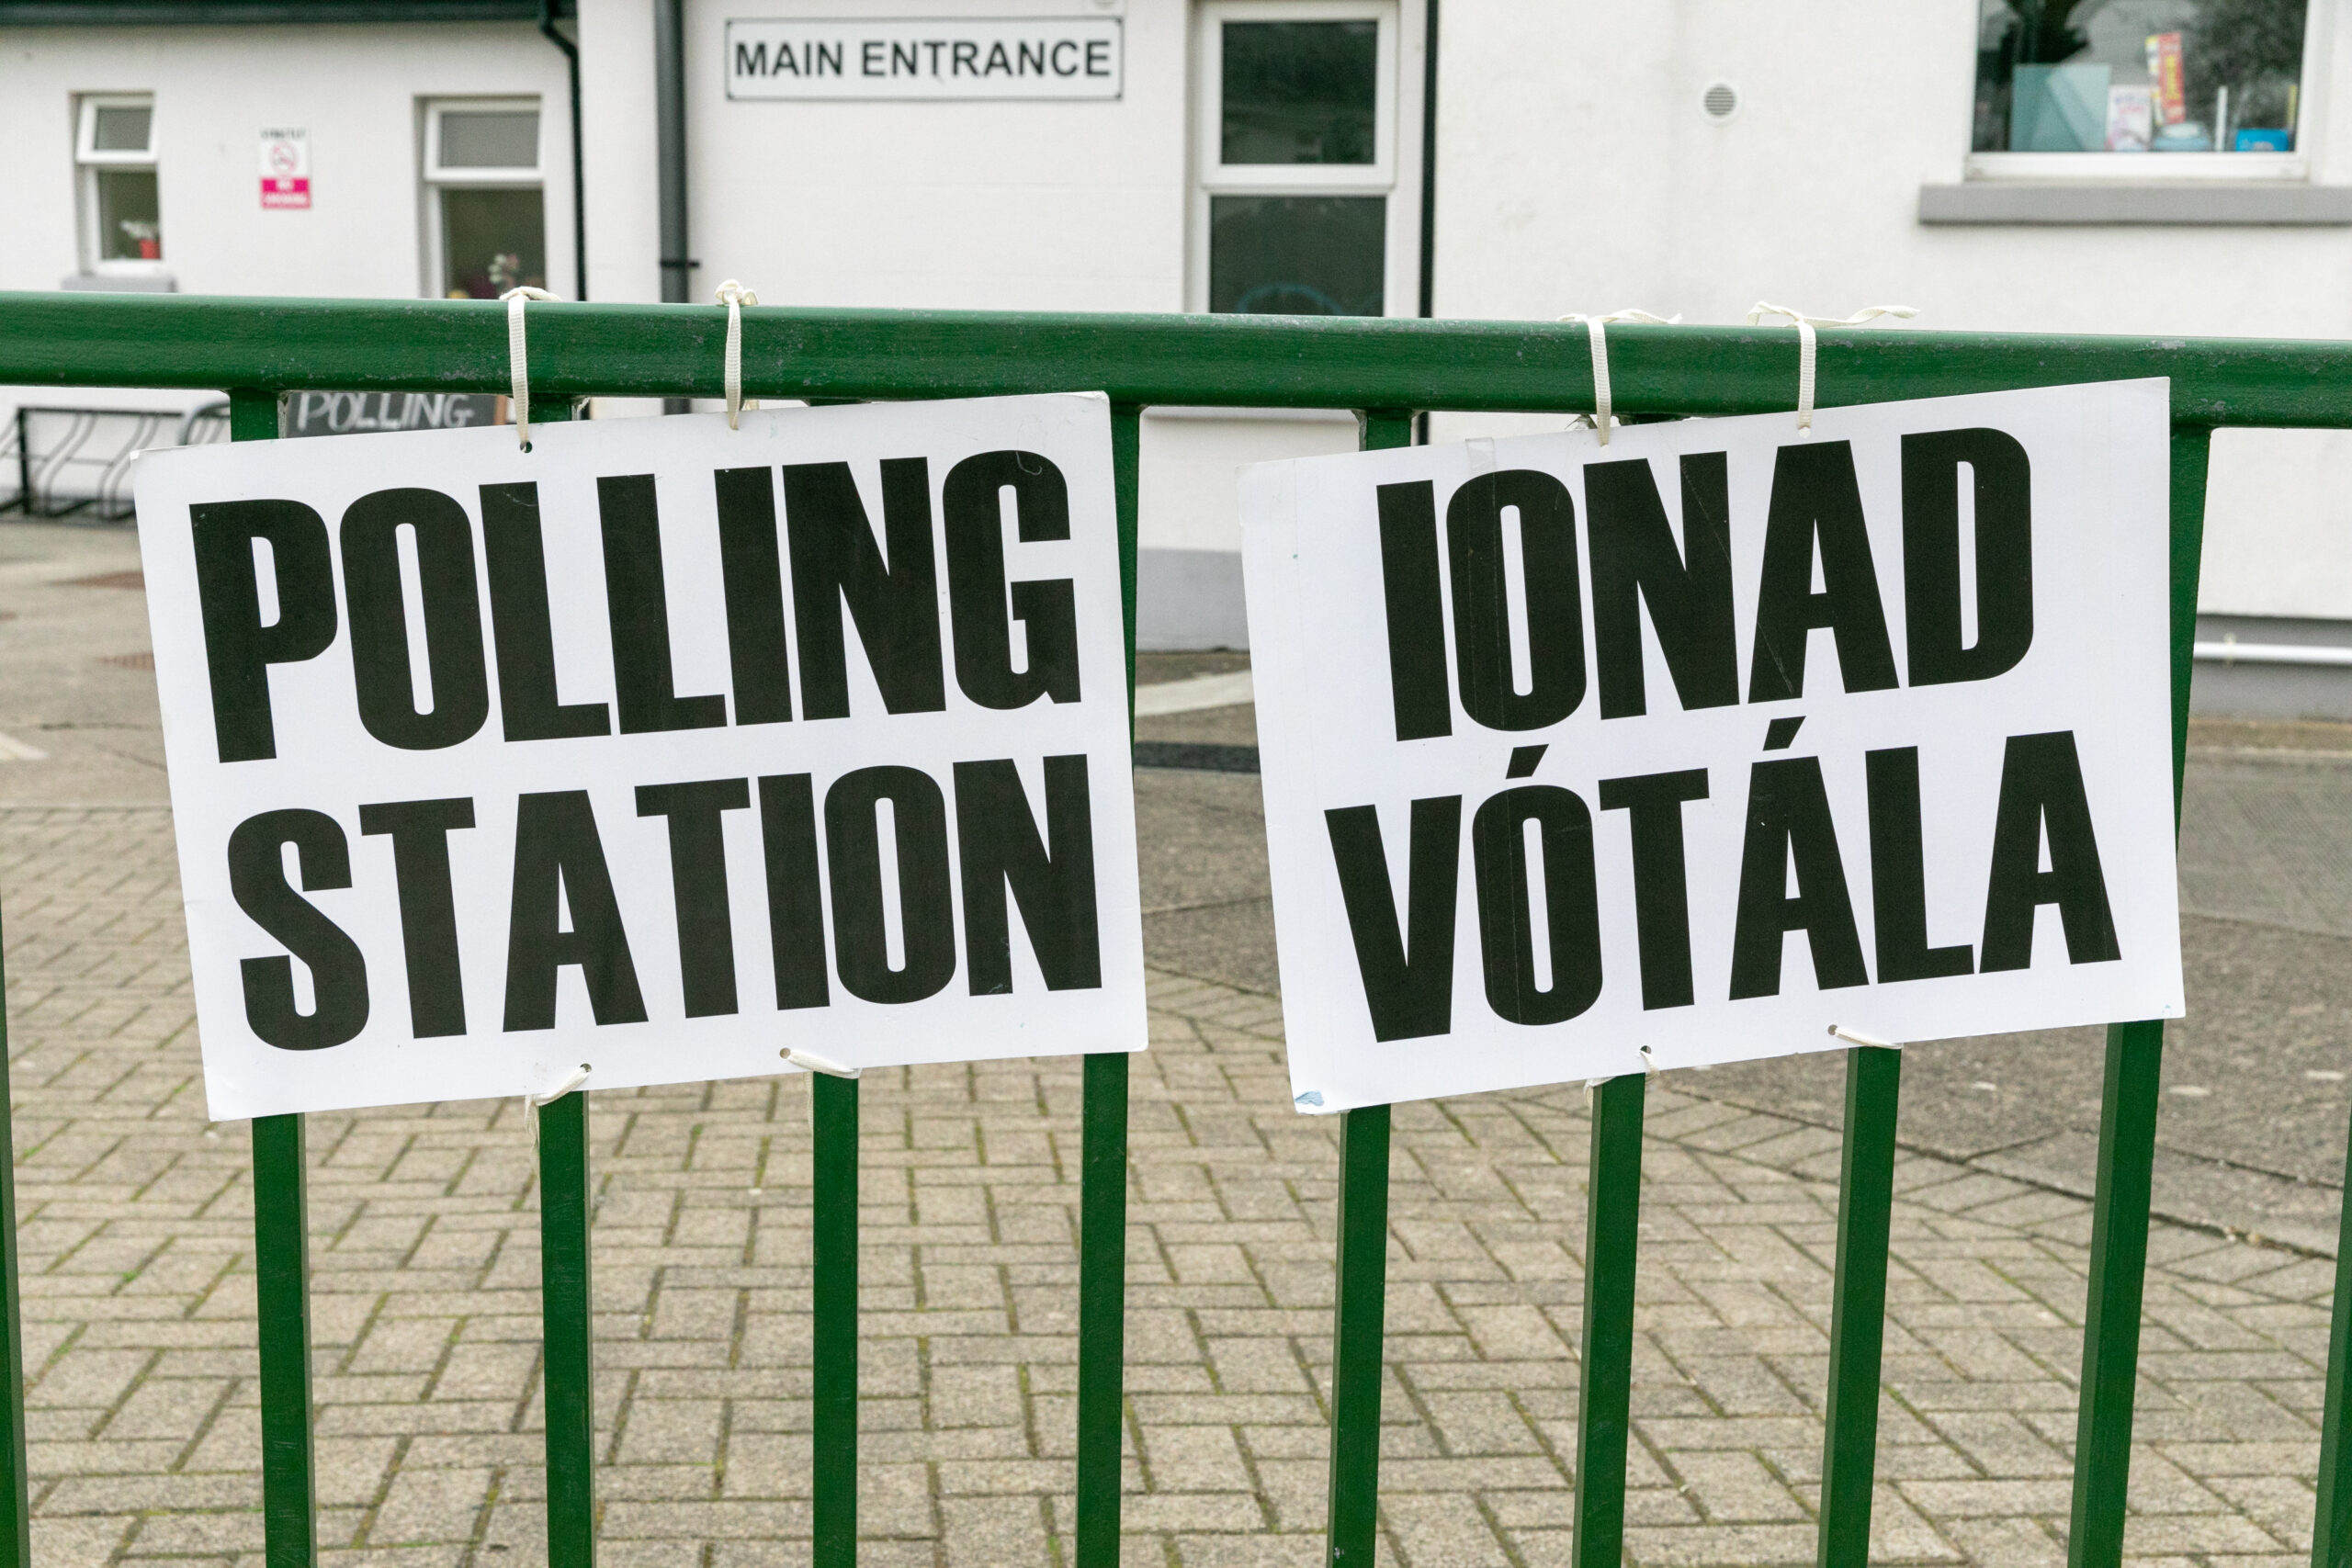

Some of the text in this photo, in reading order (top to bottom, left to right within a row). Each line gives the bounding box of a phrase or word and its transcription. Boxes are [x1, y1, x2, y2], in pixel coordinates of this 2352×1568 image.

[736, 40, 1111, 77] MAIN ENTRANCE
[297, 392, 475, 432] POLLING
[188, 449, 1081, 763] POLLING
[1376, 427, 2034, 742] IONAD
[228, 753, 1102, 1051] STATION
[1324, 716, 2121, 1043] VÓTÁLA
